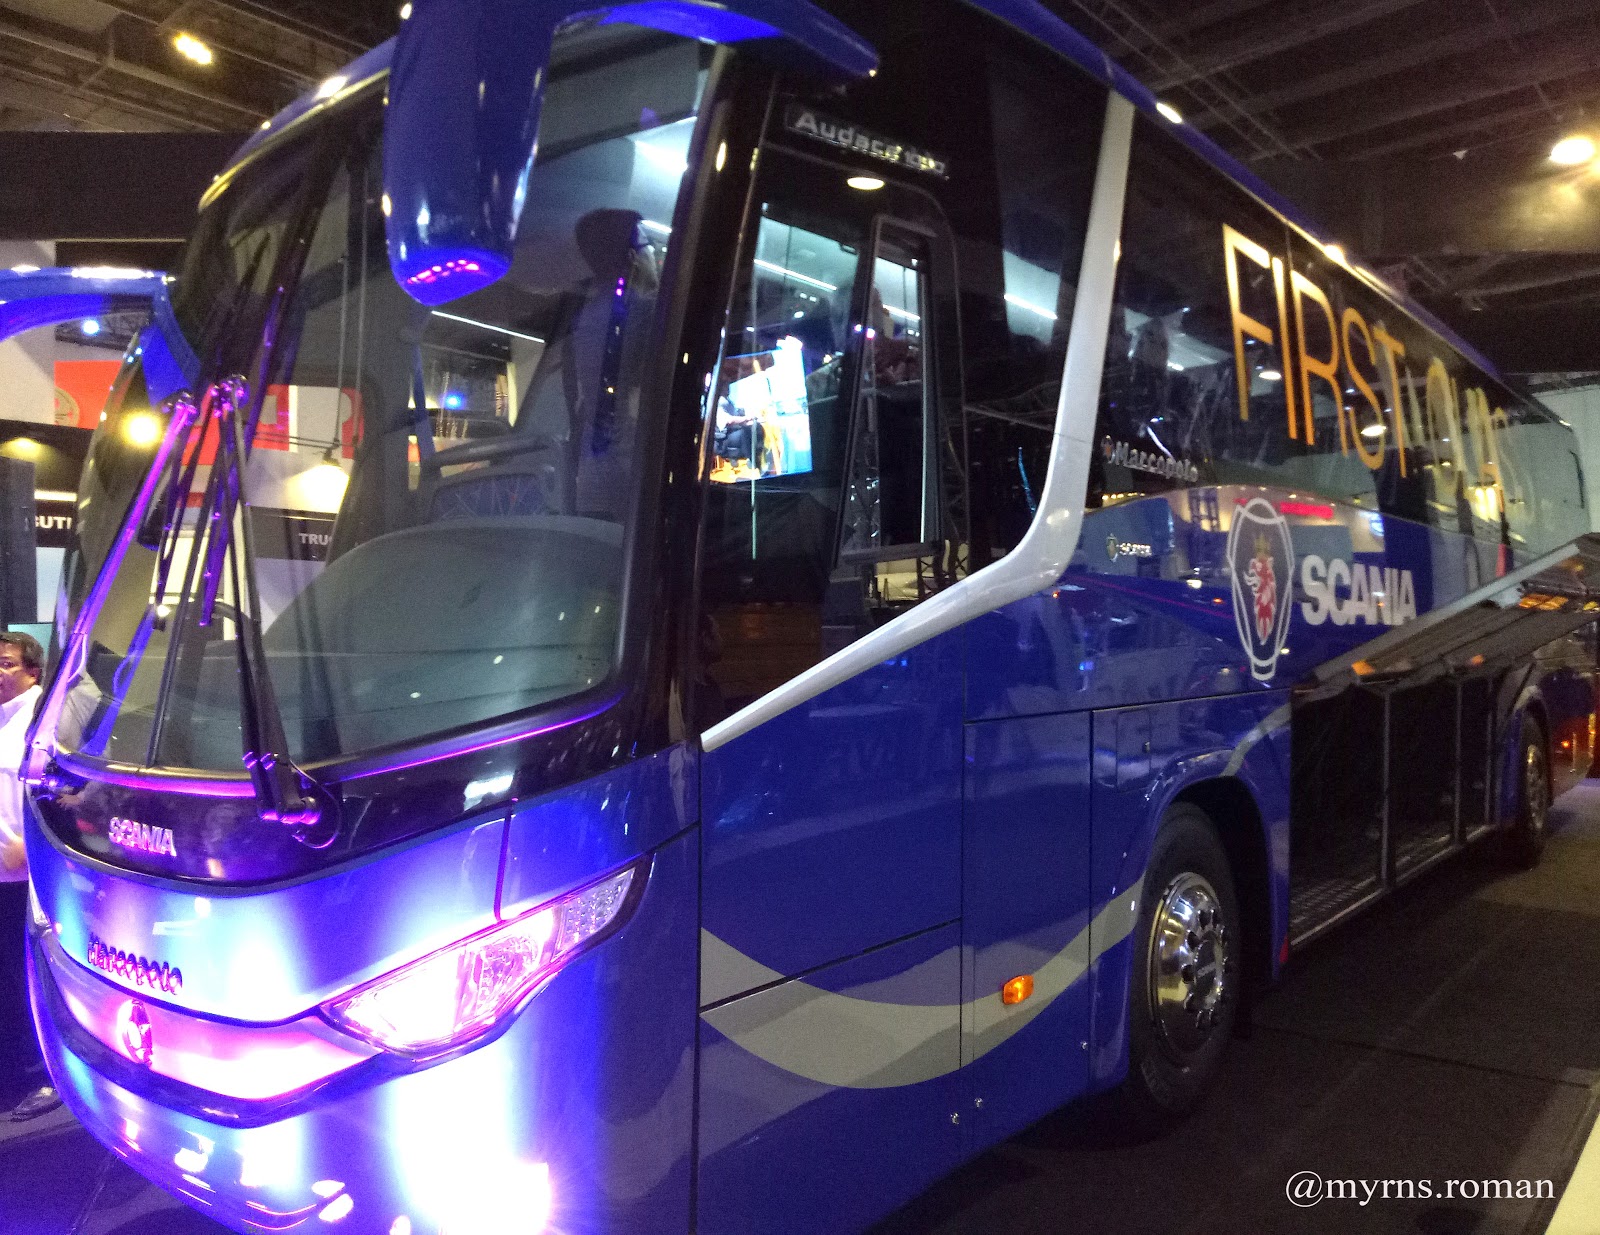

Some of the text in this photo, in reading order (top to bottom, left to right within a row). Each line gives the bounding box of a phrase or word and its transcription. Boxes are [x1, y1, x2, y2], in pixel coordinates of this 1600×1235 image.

[1222, 222, 1407, 478] FIRST
[1115, 440, 1198, 482] Marcopolo
[1301, 554, 1417, 626] SCANIA
[108, 816, 177, 857] SCANIA
[88, 931, 183, 996] Marcopolo
